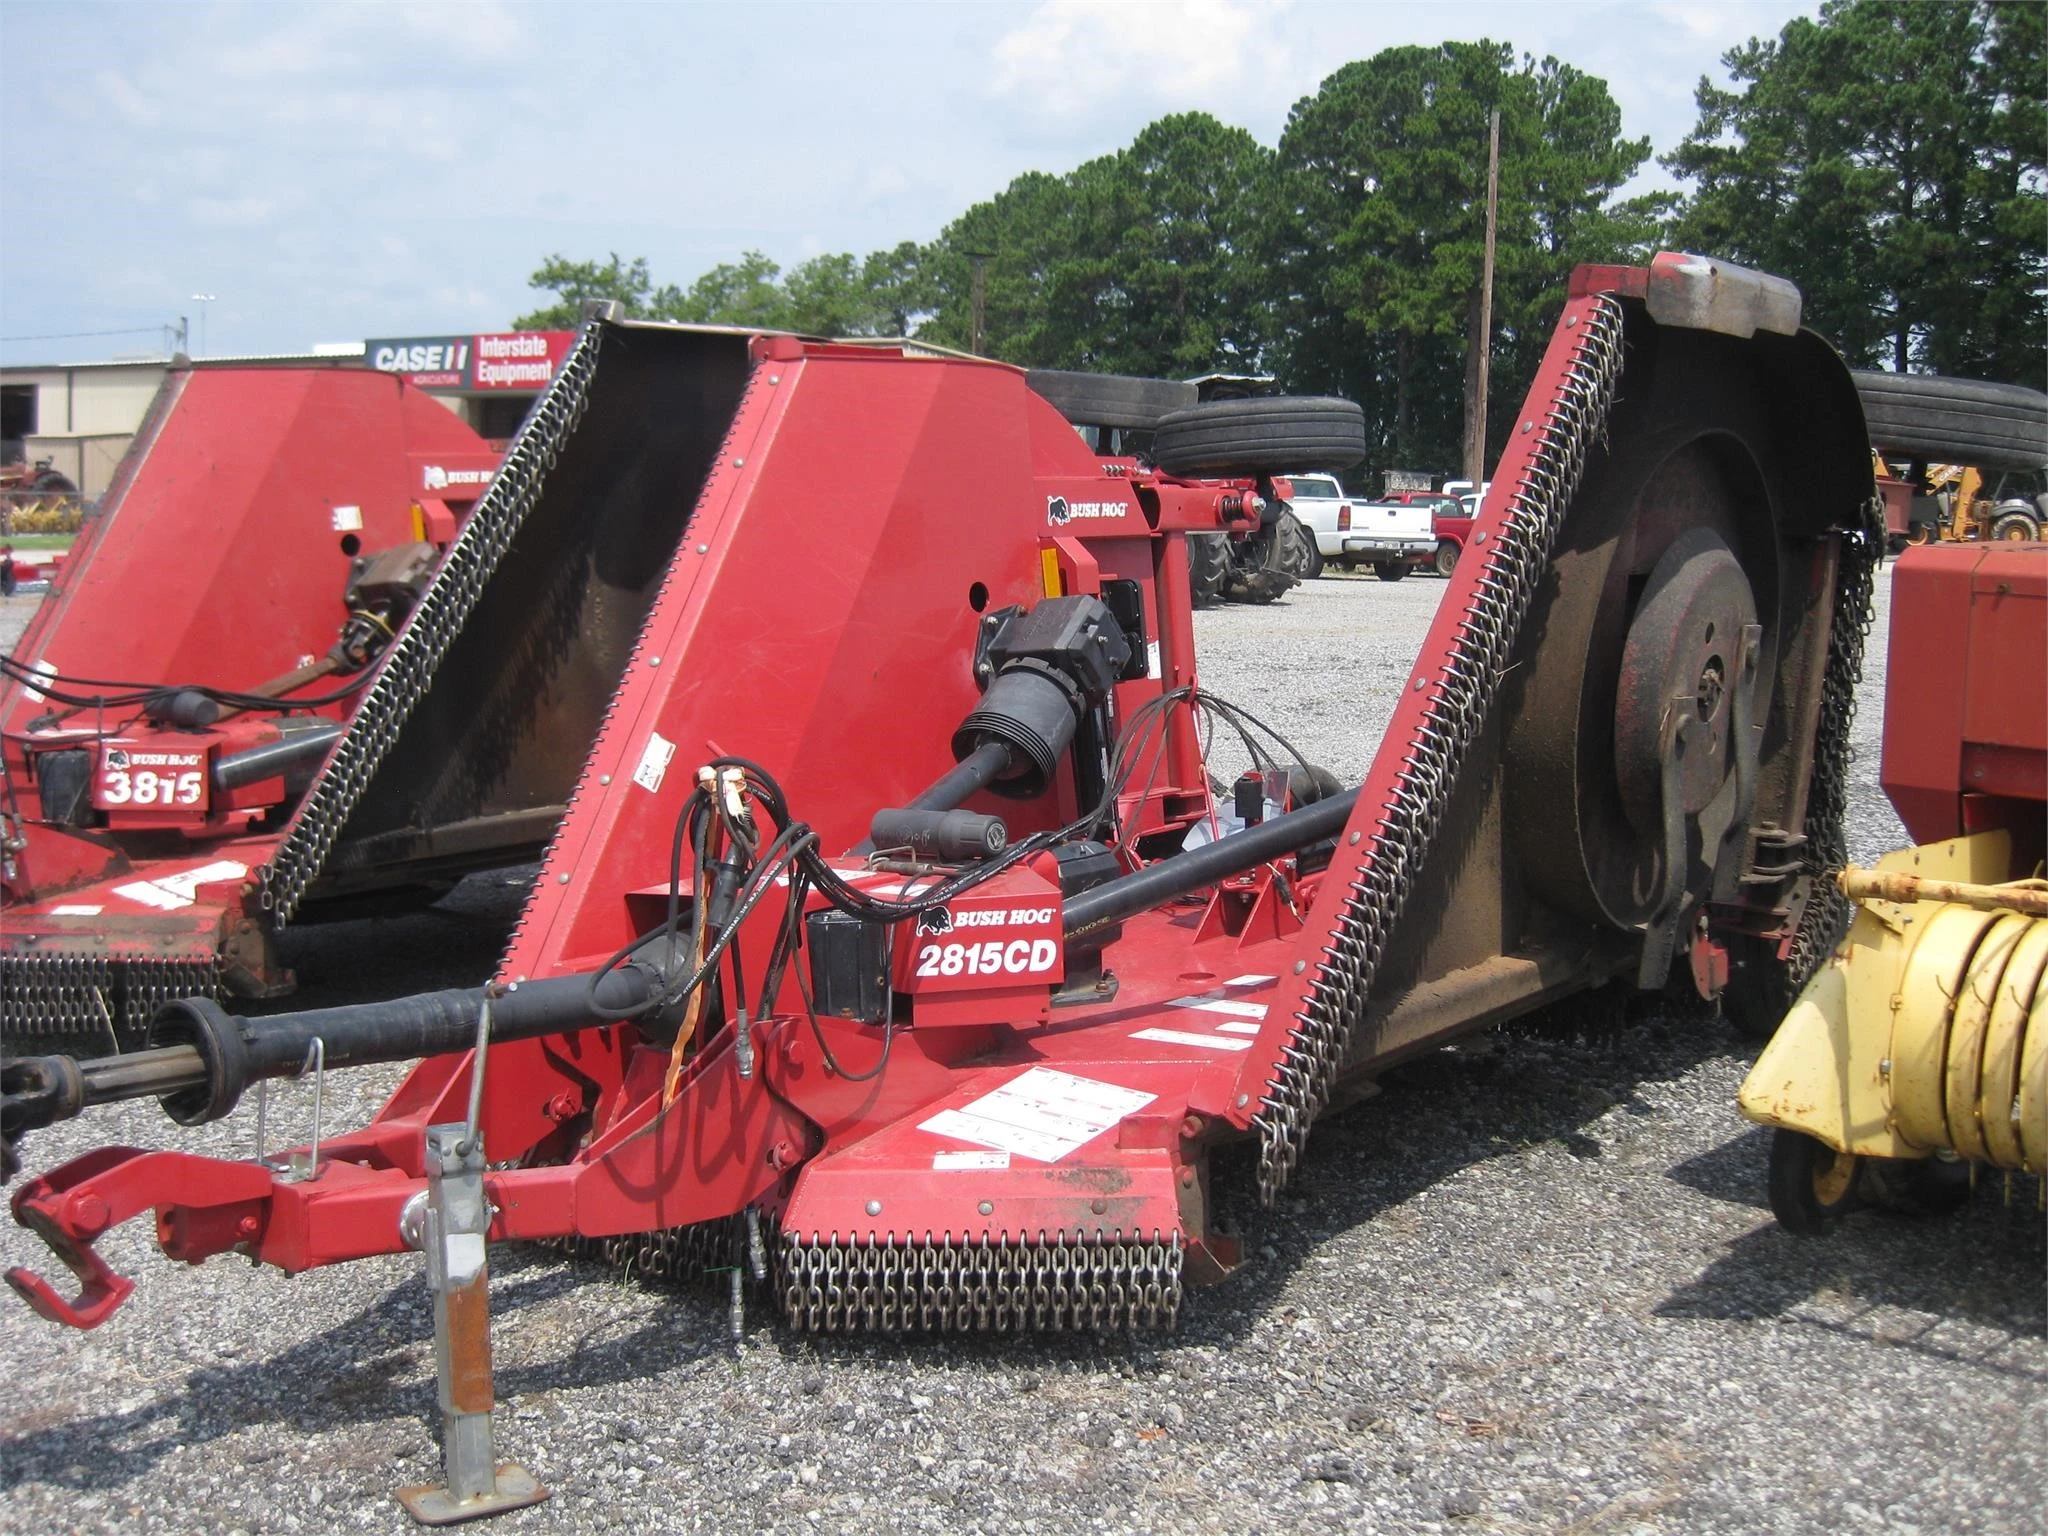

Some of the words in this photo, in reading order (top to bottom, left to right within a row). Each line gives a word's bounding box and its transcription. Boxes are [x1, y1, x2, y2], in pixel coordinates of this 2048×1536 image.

[480, 337, 547, 357] Interstate
[376, 346, 443, 371] CASE
[478, 360, 553, 386] Equipment
[1070, 503, 1101, 518] BUSH
[1101, 502, 1126, 517] HOG
[131, 753, 168, 766] BUSH
[168, 753, 199, 766] HOG
[104, 771, 203, 804] 3815
[954, 910, 1007, 927] BUSH
[1007, 908, 1053, 926] HOG
[916, 938, 1057, 977] 2815CD
